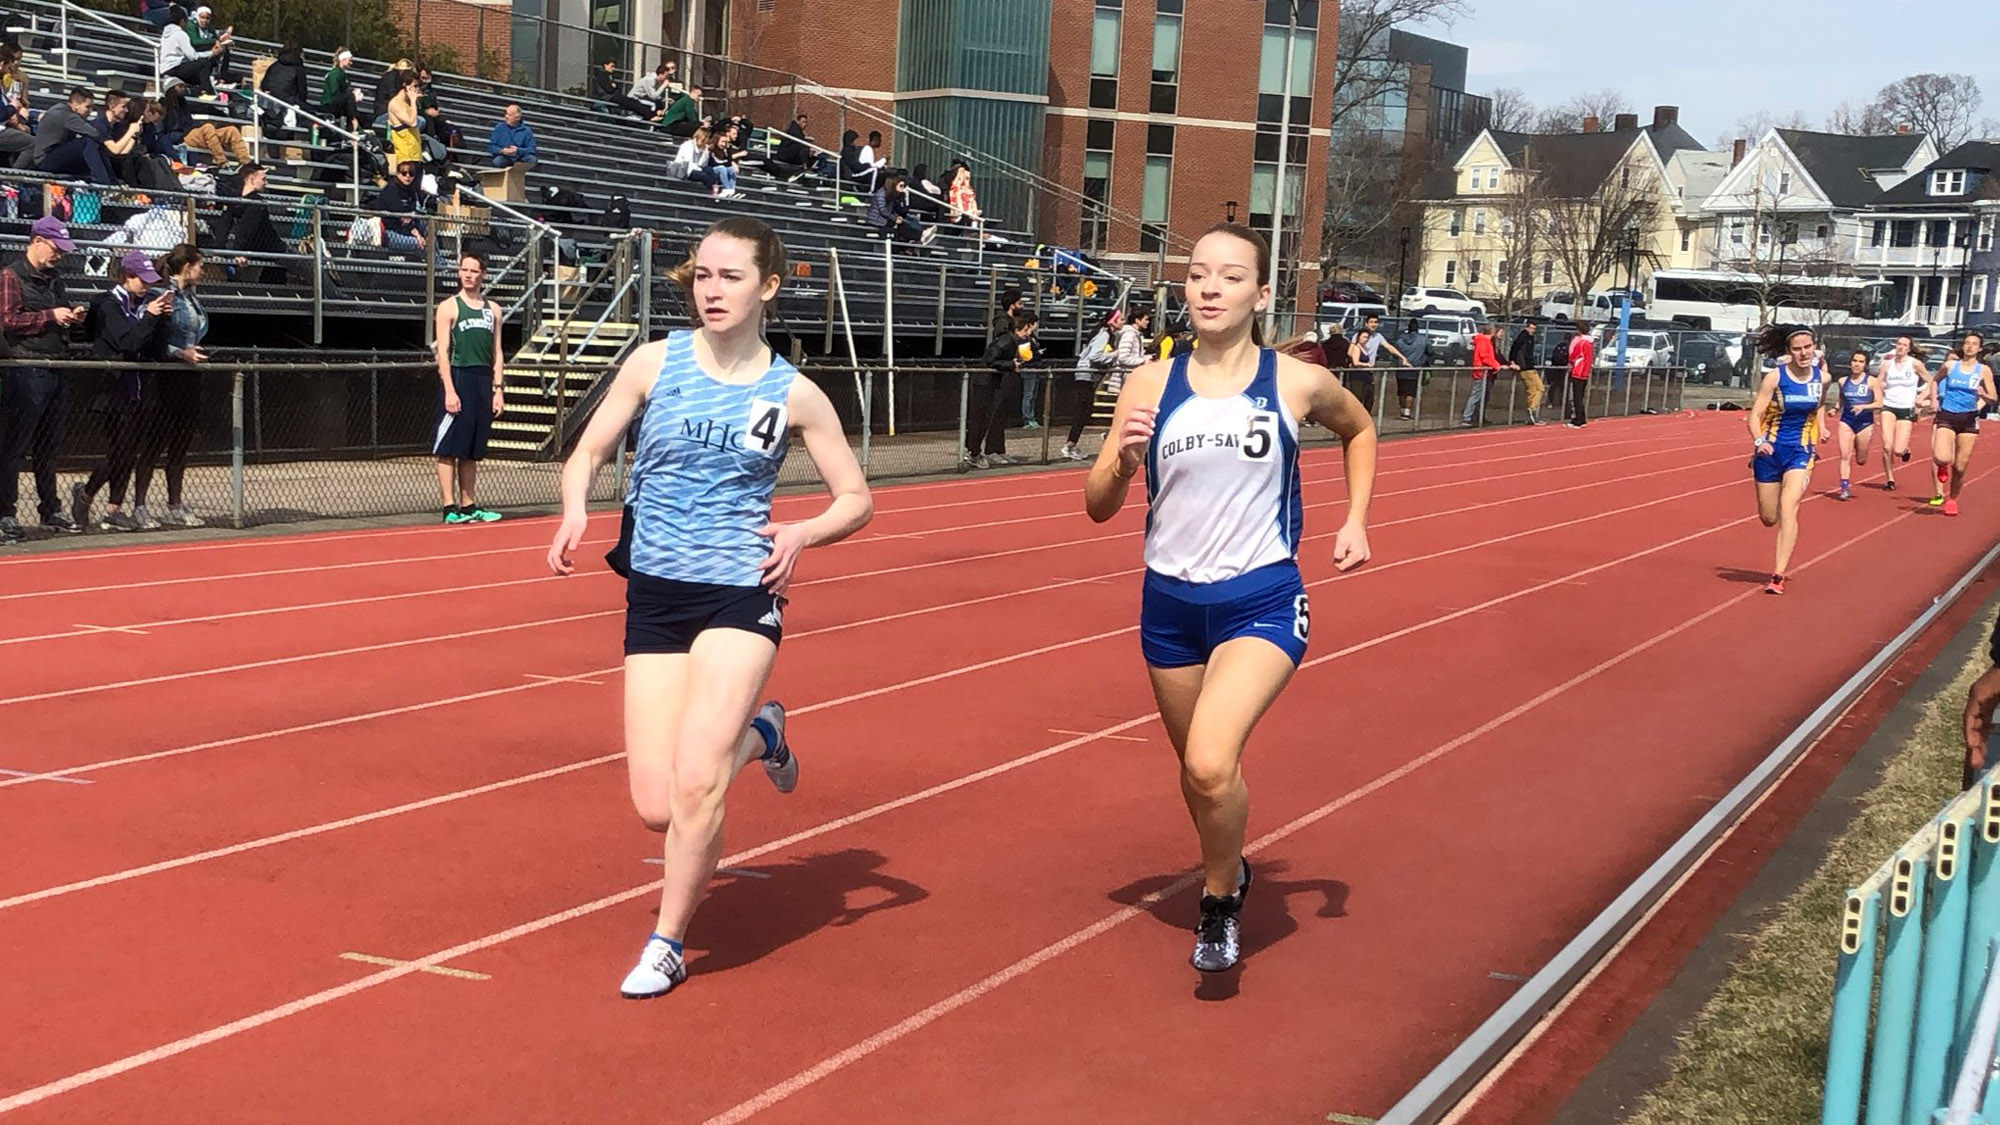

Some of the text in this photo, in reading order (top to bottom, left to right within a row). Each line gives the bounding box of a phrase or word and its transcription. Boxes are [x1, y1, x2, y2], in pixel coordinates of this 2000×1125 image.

[484, 310, 492, 324] 5
[1971, 378, 1979, 387] 7
[1809, 384, 1821, 396] 14
[1859, 386, 1866, 395] 3
[751, 407, 780, 450] 4
[1243, 415, 1271, 459] 5
